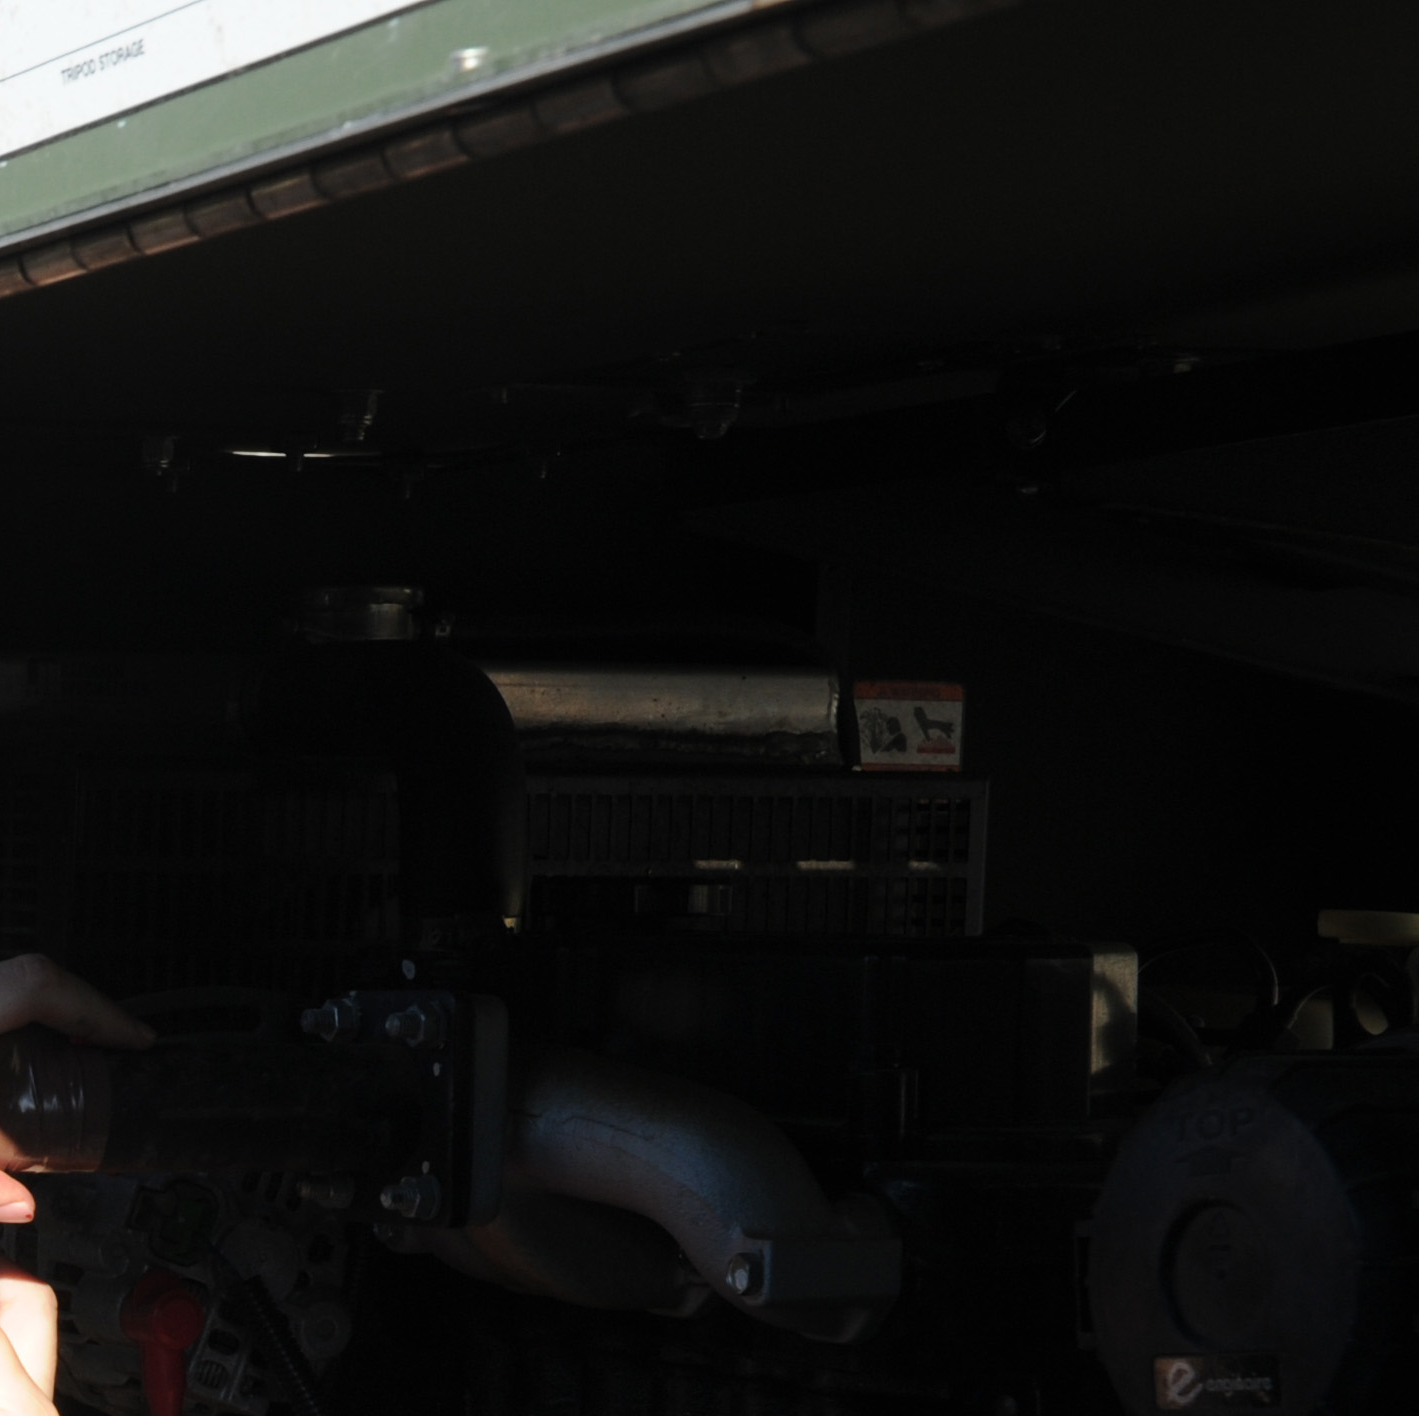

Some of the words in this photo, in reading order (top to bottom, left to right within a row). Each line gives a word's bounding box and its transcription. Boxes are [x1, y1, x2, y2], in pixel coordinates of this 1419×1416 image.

[61, 56, 96, 85] TRIPOD
[99, 39, 145, 72] STORAGE
[1173, 1106, 1253, 1142] TOP
